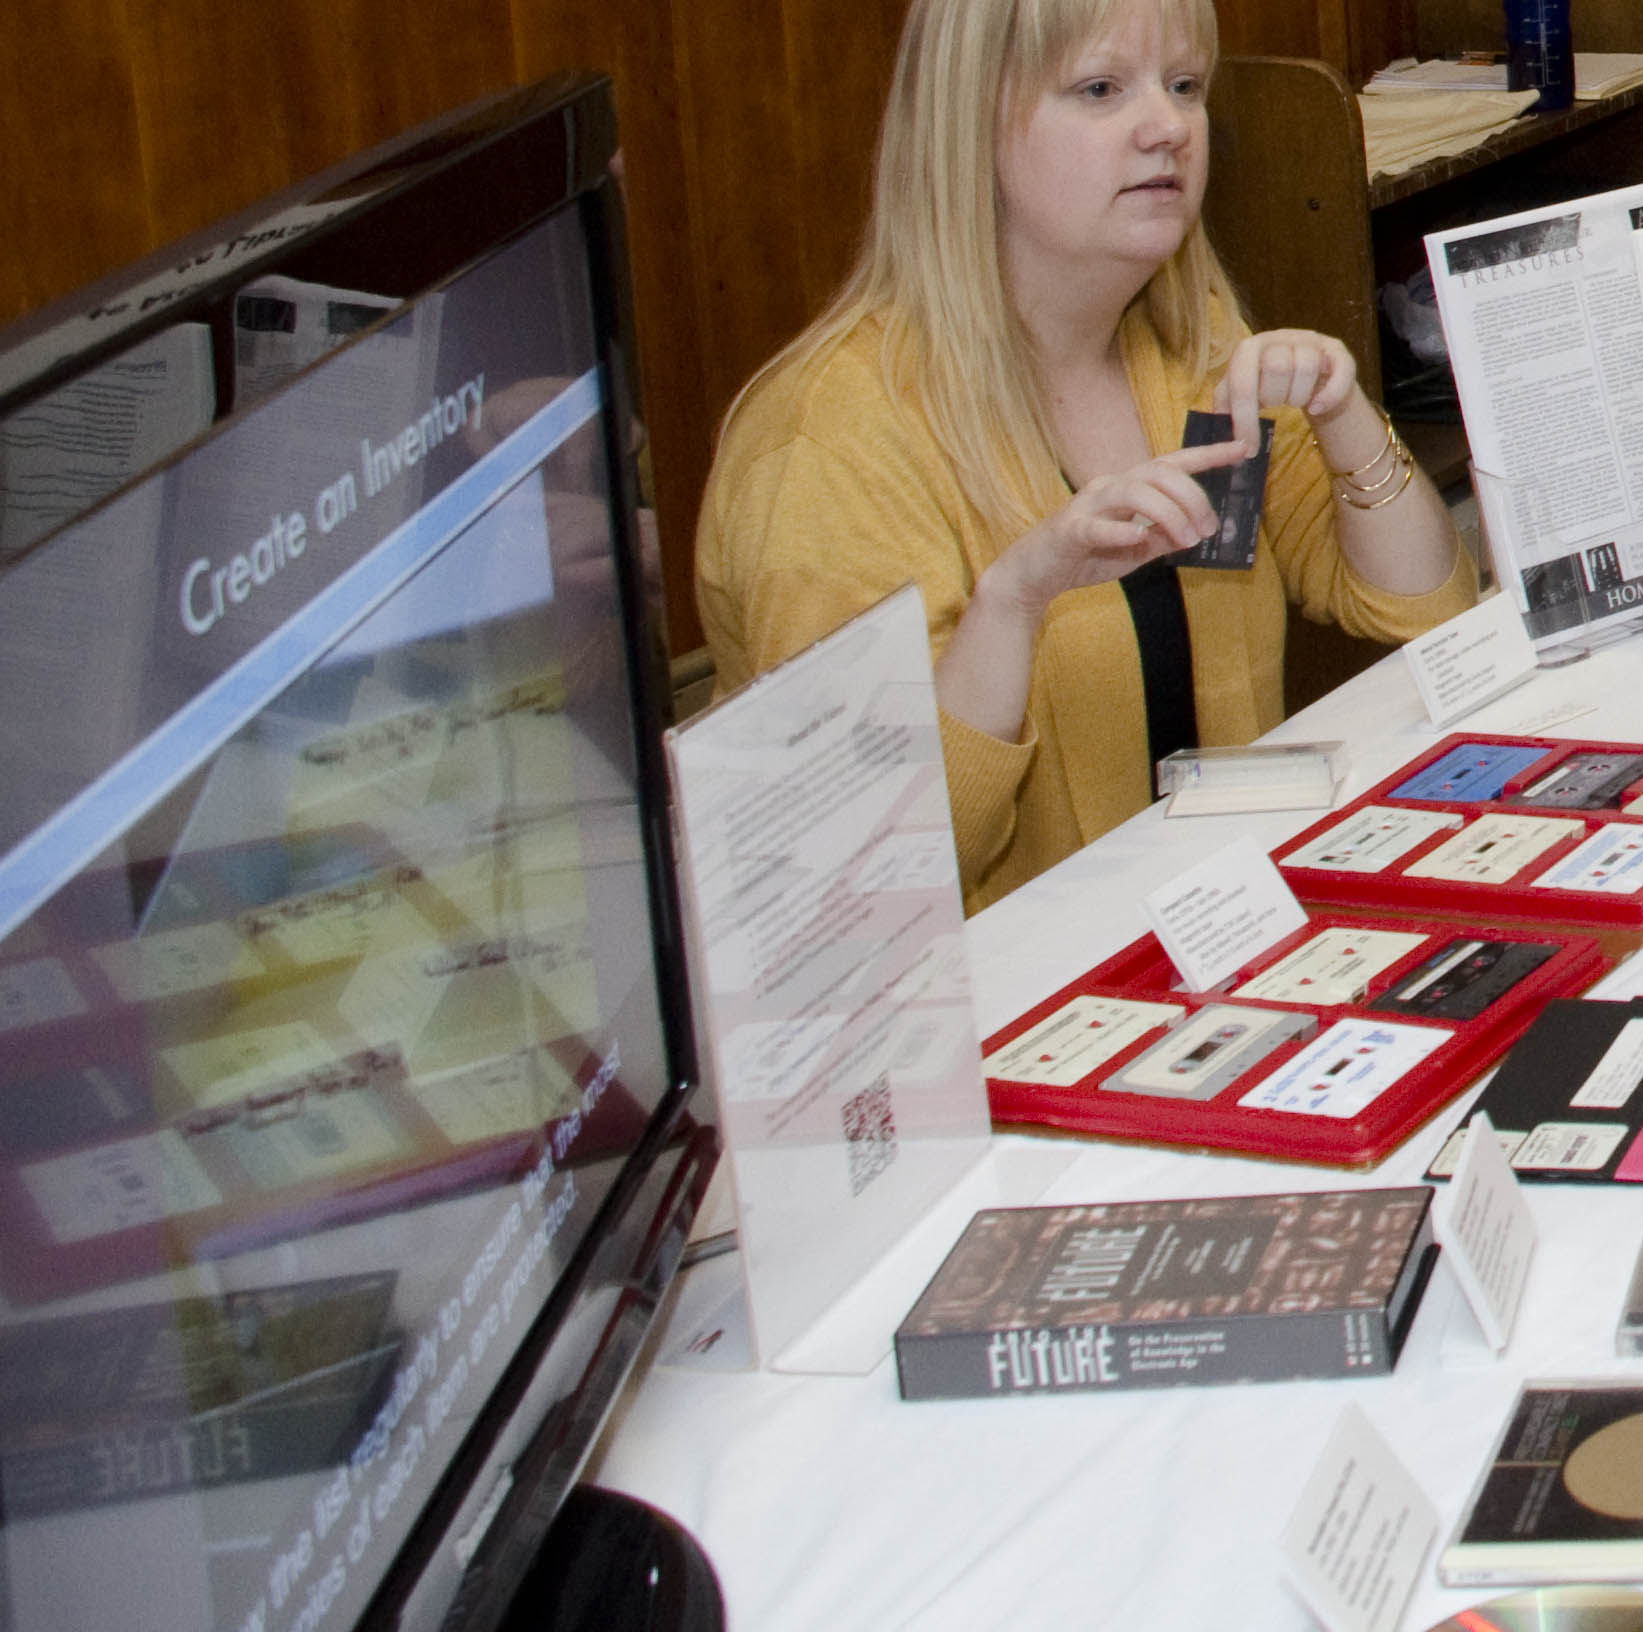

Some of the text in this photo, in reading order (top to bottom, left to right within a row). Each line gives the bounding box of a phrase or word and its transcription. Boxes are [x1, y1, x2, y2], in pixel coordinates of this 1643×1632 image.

[1461, 246, 1586, 289] TREASURES
[179, 370, 487, 636] Create an Inventory
[1143, 1345, 1195, 1359] Knowledge
[1163, 1331, 1226, 1346] Preservation
[987, 1337, 1120, 1391] FUTURE
